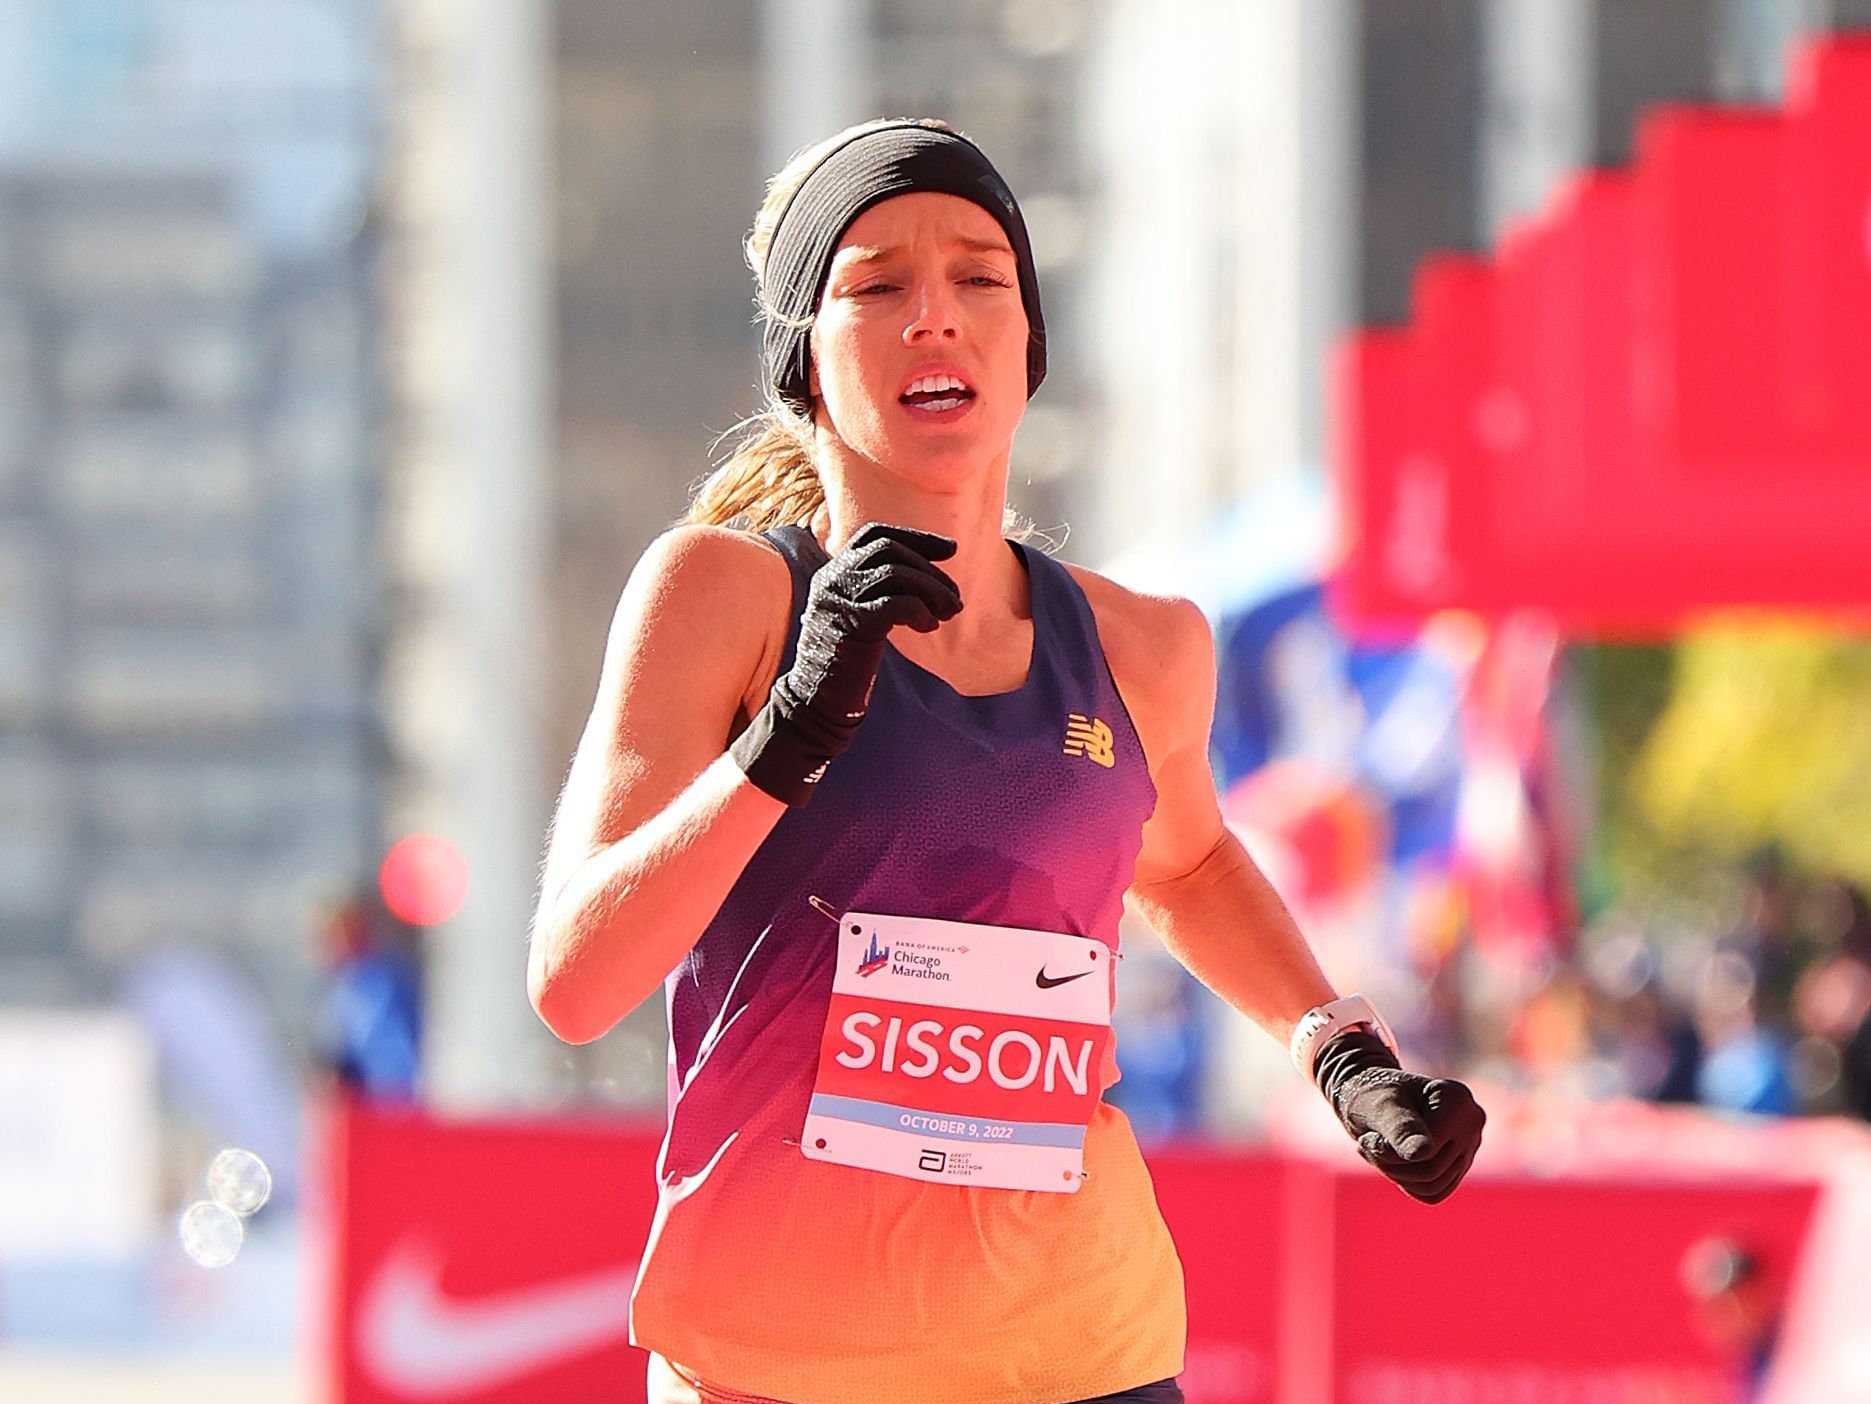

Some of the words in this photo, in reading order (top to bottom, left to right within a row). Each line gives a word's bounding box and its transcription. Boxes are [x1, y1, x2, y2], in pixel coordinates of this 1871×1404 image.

[894, 950, 942, 969] Chicago
[892, 963, 950, 981] Marathon
[835, 1011, 1094, 1095] SISSON
[900, 1114, 966, 1135] OCTOBER
[968, 1123, 980, 1138] 9,
[983, 1125, 1014, 1139] 2022
